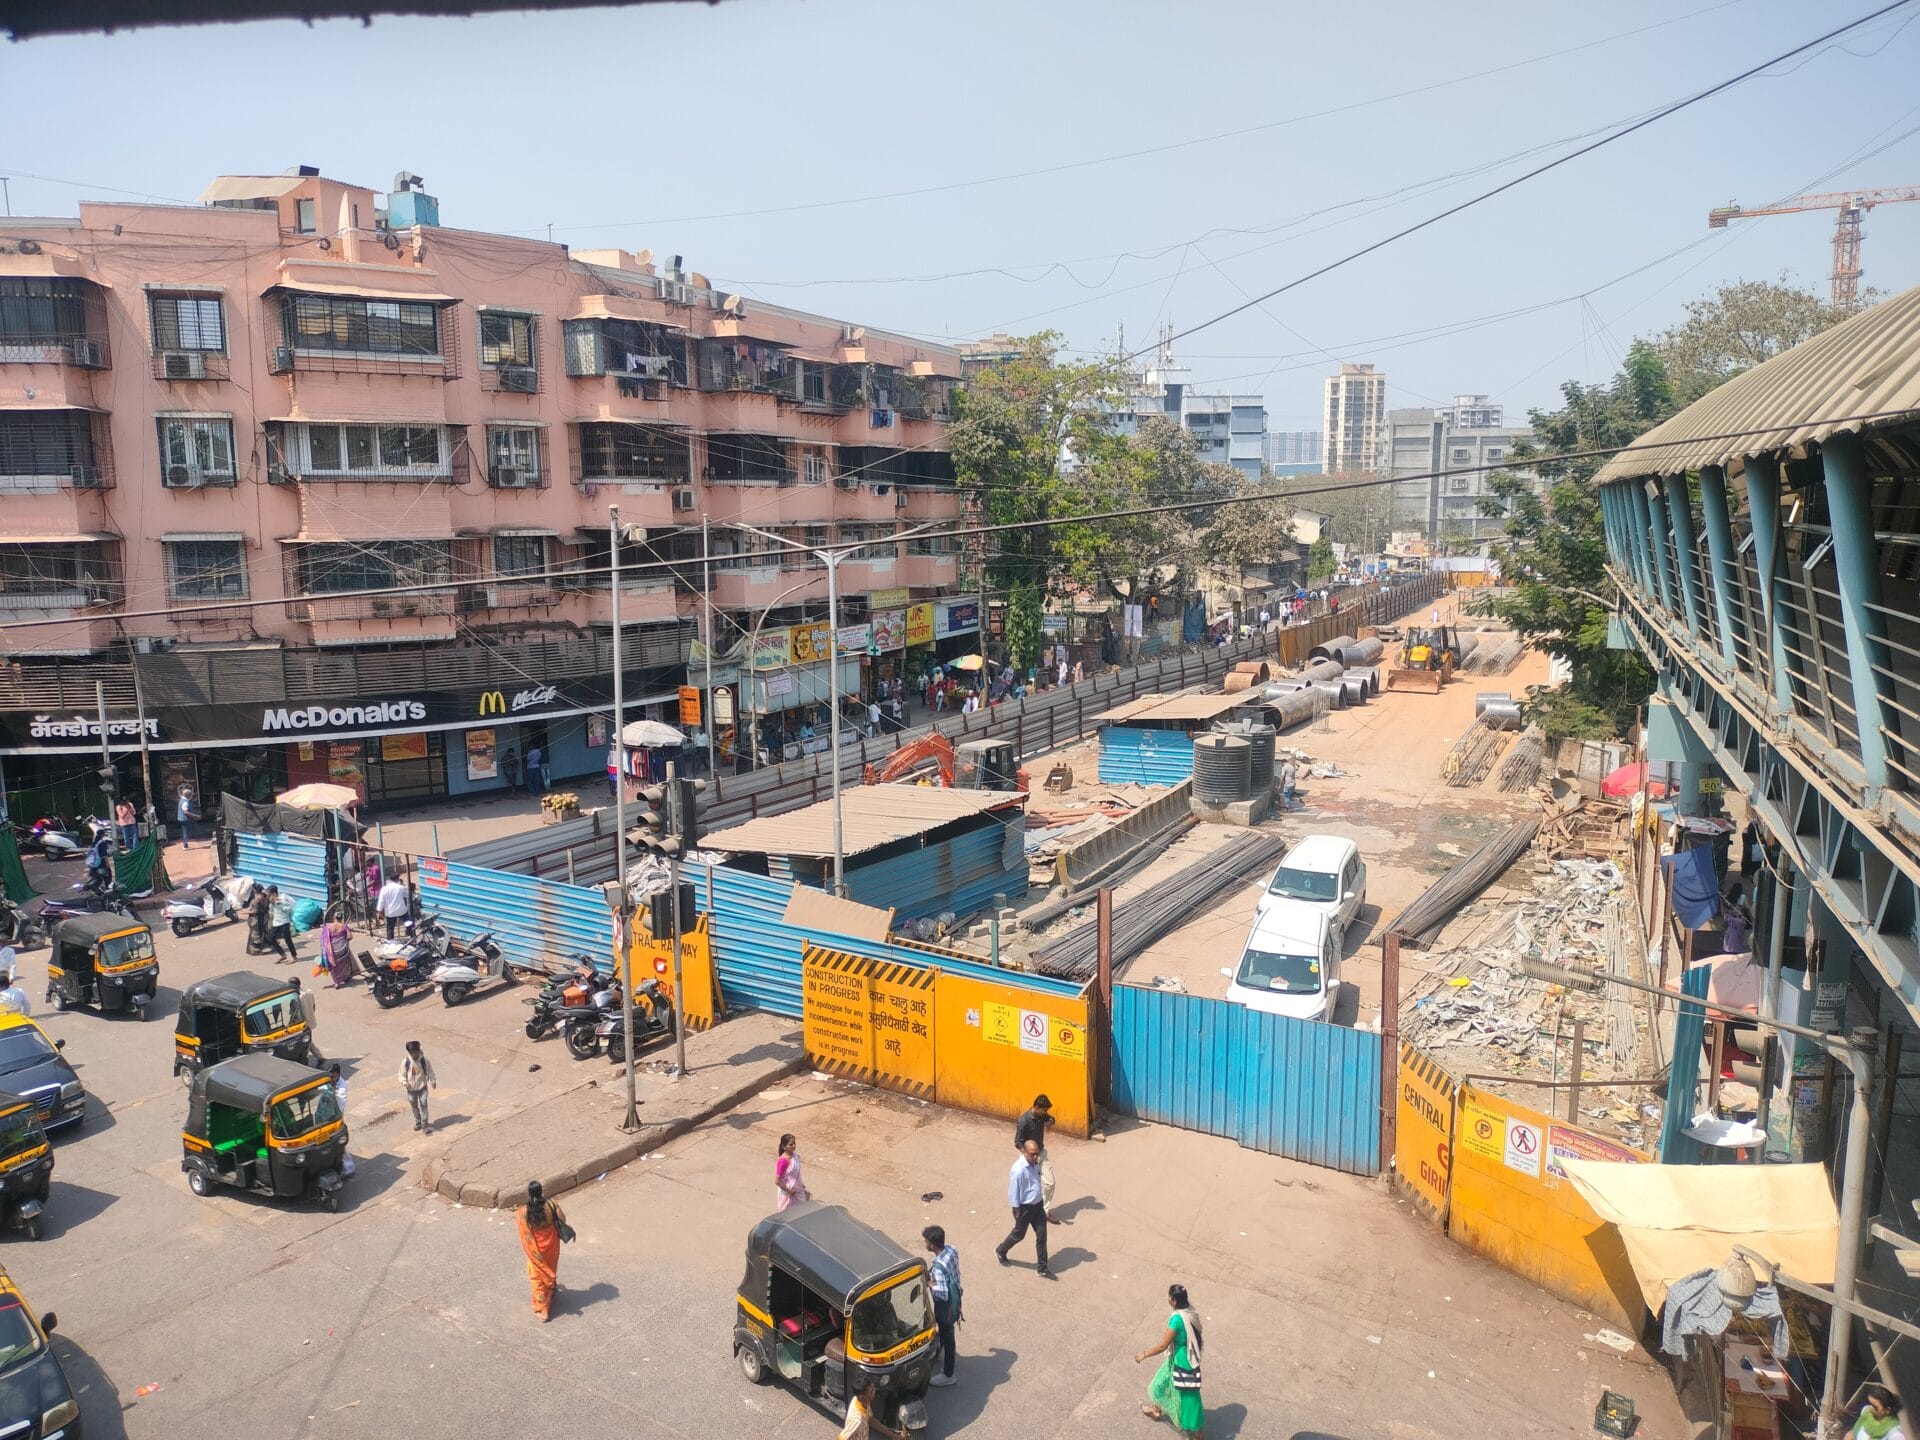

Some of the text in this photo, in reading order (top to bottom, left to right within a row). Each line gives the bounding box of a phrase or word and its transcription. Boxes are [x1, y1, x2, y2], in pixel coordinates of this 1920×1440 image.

[262, 701, 427, 731] McDonald's
[661, 939, 698, 958] RAWAY
[805, 967, 863, 989] CONSTRUCTION
[808, 981, 860, 1002] IN PROGRESS
[807, 997, 815, 1006] We
[844, 1006, 852, 1015] for
[853, 1010, 863, 1019] any
[869, 990, 885, 1004] काम
[910, 999, 927, 1017] आहे
[849, 1021, 863, 1031] while
[831, 1045, 859, 1056] progress
[850, 1036, 863, 1045] work
[884, 1039, 901, 1056] आहे
[1404, 1083, 1446, 1133] CENTRAL
